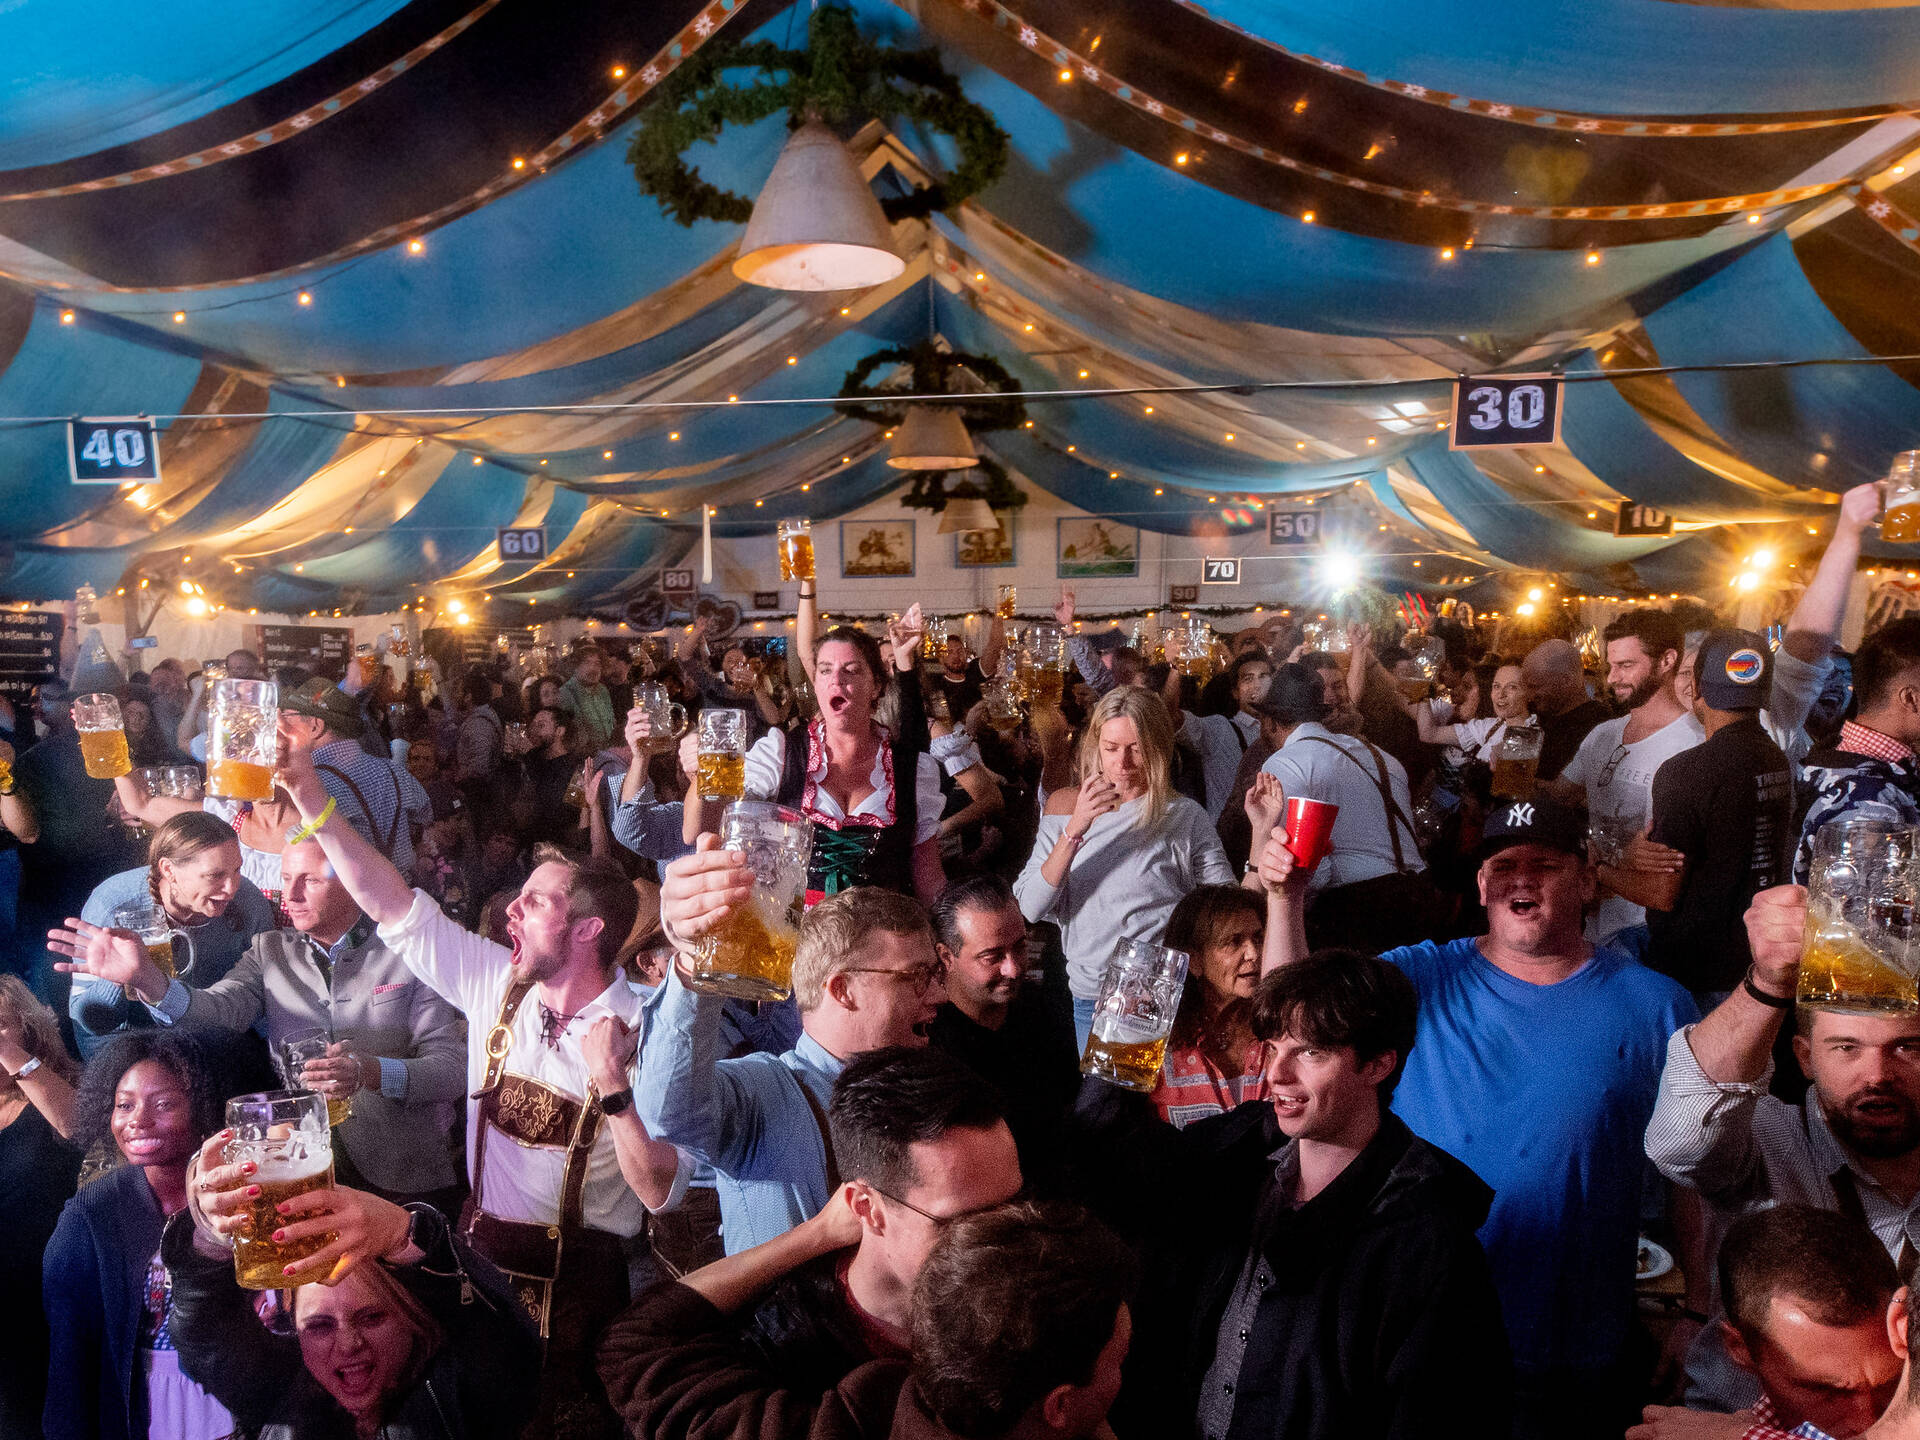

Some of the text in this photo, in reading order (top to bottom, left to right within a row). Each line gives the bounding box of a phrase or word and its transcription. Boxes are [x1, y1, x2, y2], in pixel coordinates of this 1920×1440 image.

[1467, 384, 1546, 431] 30
[81, 428, 147, 468] 40
[1274, 513, 1316, 538] 50
[1629, 504, 1666, 528] 10
[503, 531, 540, 554] 60
[665, 572, 690, 588] 80
[1207, 561, 1235, 578] 70
[1173, 587, 1197, 600] 90
[1506, 802, 1536, 827] NY
